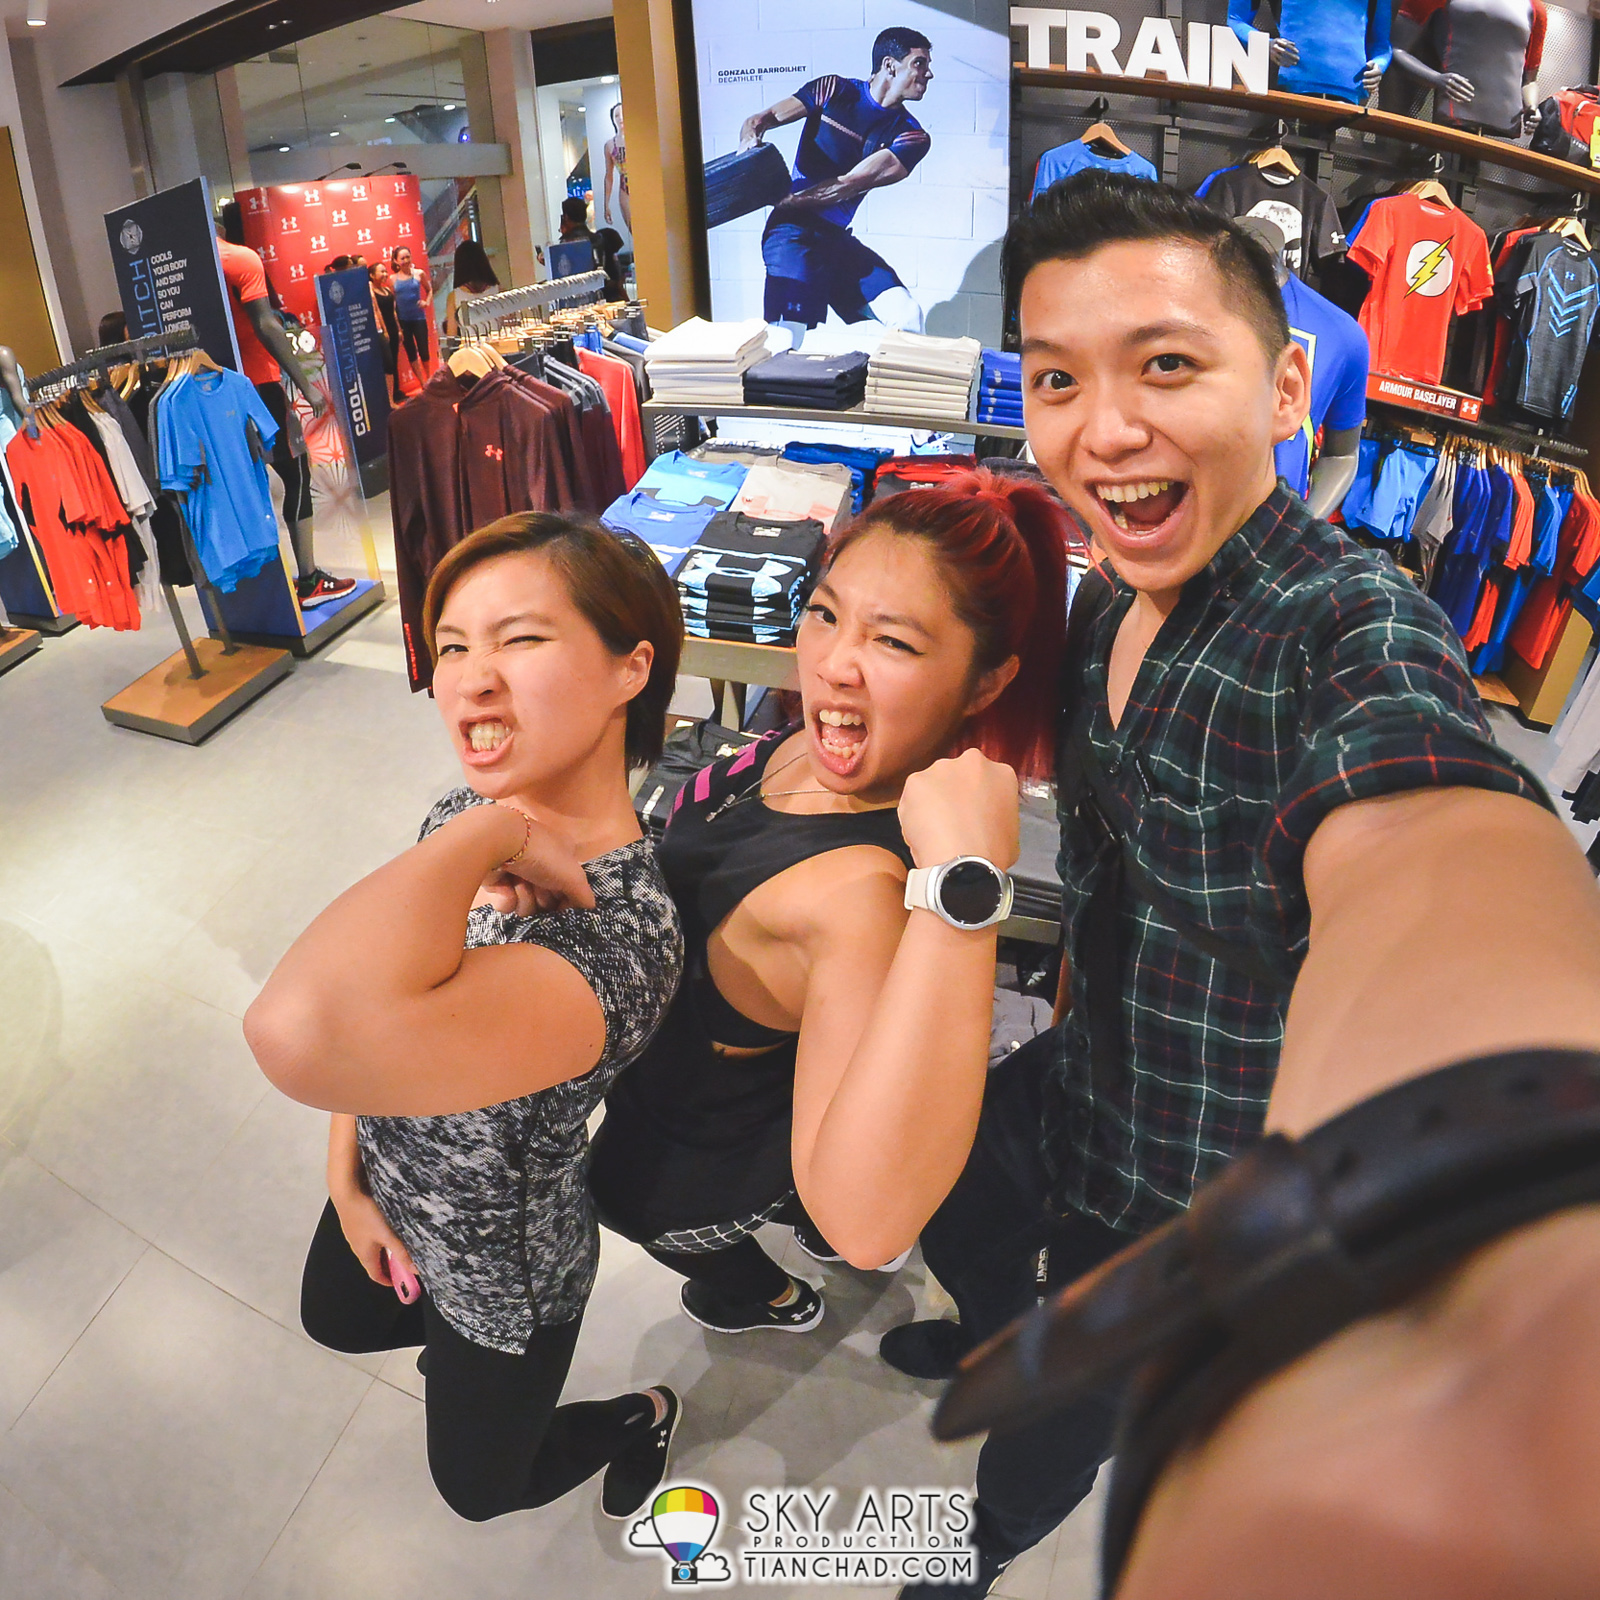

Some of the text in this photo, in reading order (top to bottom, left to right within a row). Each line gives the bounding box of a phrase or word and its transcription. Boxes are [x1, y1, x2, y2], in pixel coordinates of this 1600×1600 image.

[1010, 7, 1269, 95] TRAIN
[718, 65, 806, 76] GONZALO BARROILHET
[718, 75, 763, 83] DECATHLETE
[151, 251, 173, 264] COOLS
[153, 259, 187, 275] YOUR BODY
[156, 272, 184, 287] AND SKIN
[158, 286, 181, 299] SO YOU
[160, 300, 174, 310] CAN
[162, 307, 192, 321] PERFORM
[165, 320, 191, 334] LONGER
[1379, 380, 1457, 409] ARMOUR BASELAYER
